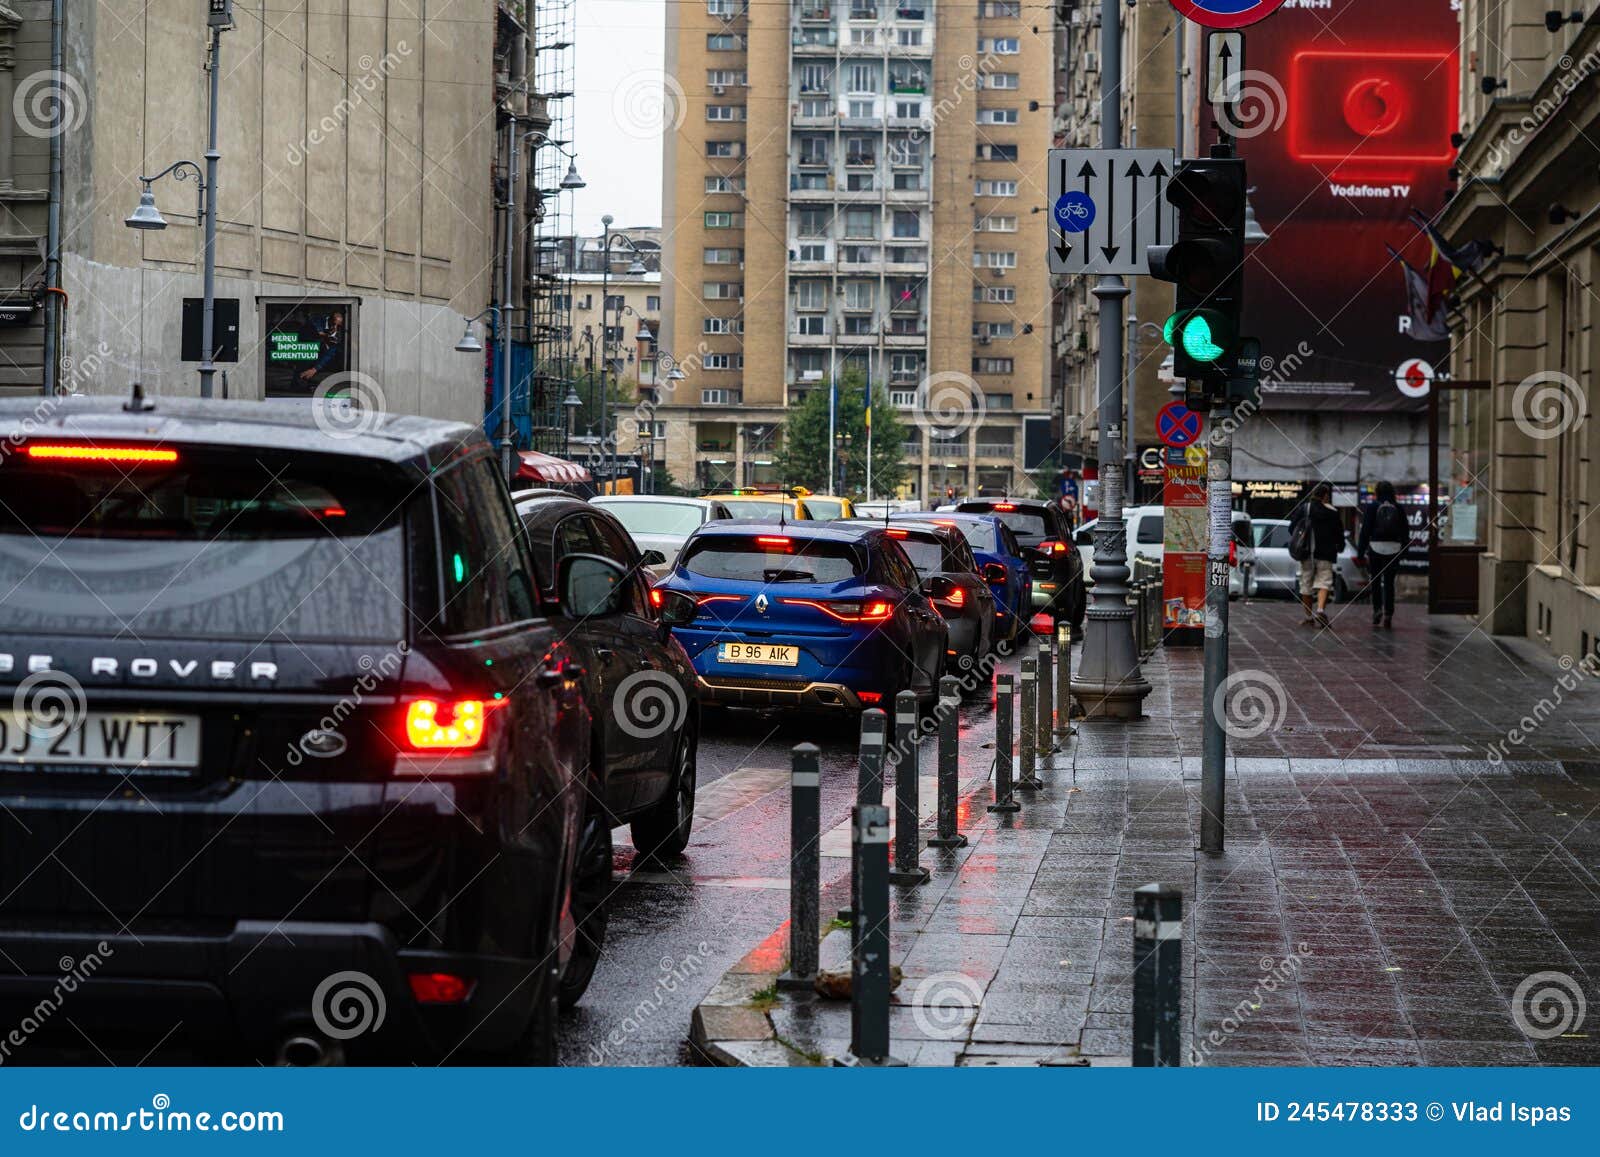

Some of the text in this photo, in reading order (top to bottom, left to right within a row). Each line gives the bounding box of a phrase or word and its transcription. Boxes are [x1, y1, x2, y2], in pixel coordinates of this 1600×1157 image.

[1330, 184, 1410, 197] Vodafone TV
[277, 342, 319, 351] ÎMPOTRIVA
[731, 645, 789, 660] B 96 AIK
[91, 657, 278, 679] ROVER
[47, 720, 86, 757] 21
[101, 719, 185, 759] WTT
